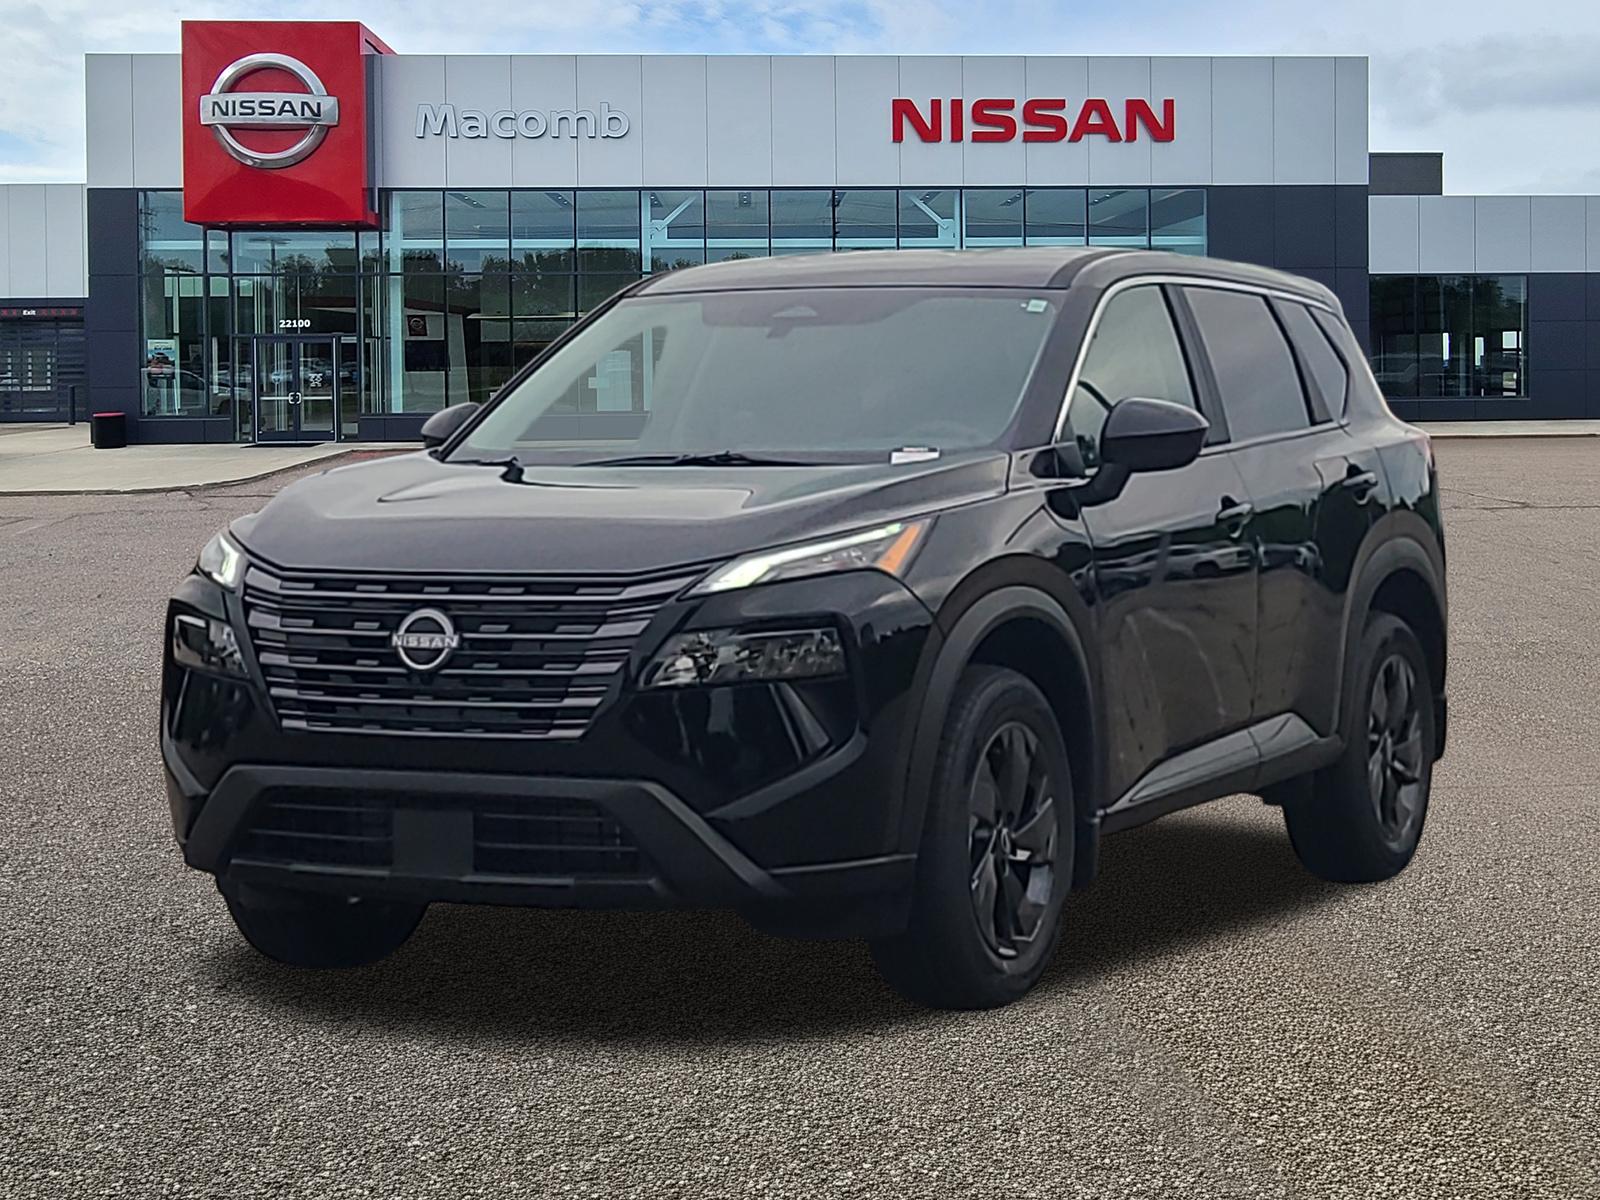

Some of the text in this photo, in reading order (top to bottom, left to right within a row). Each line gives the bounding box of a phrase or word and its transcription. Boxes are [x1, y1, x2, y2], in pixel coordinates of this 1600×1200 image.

[212, 100, 322, 118] NISSAN
[415, 101, 630, 139] Macomb
[892, 98, 1175, 142] NISSAN
[279, 319, 311, 328] 22100
[392, 633, 459, 648] NISSAN
